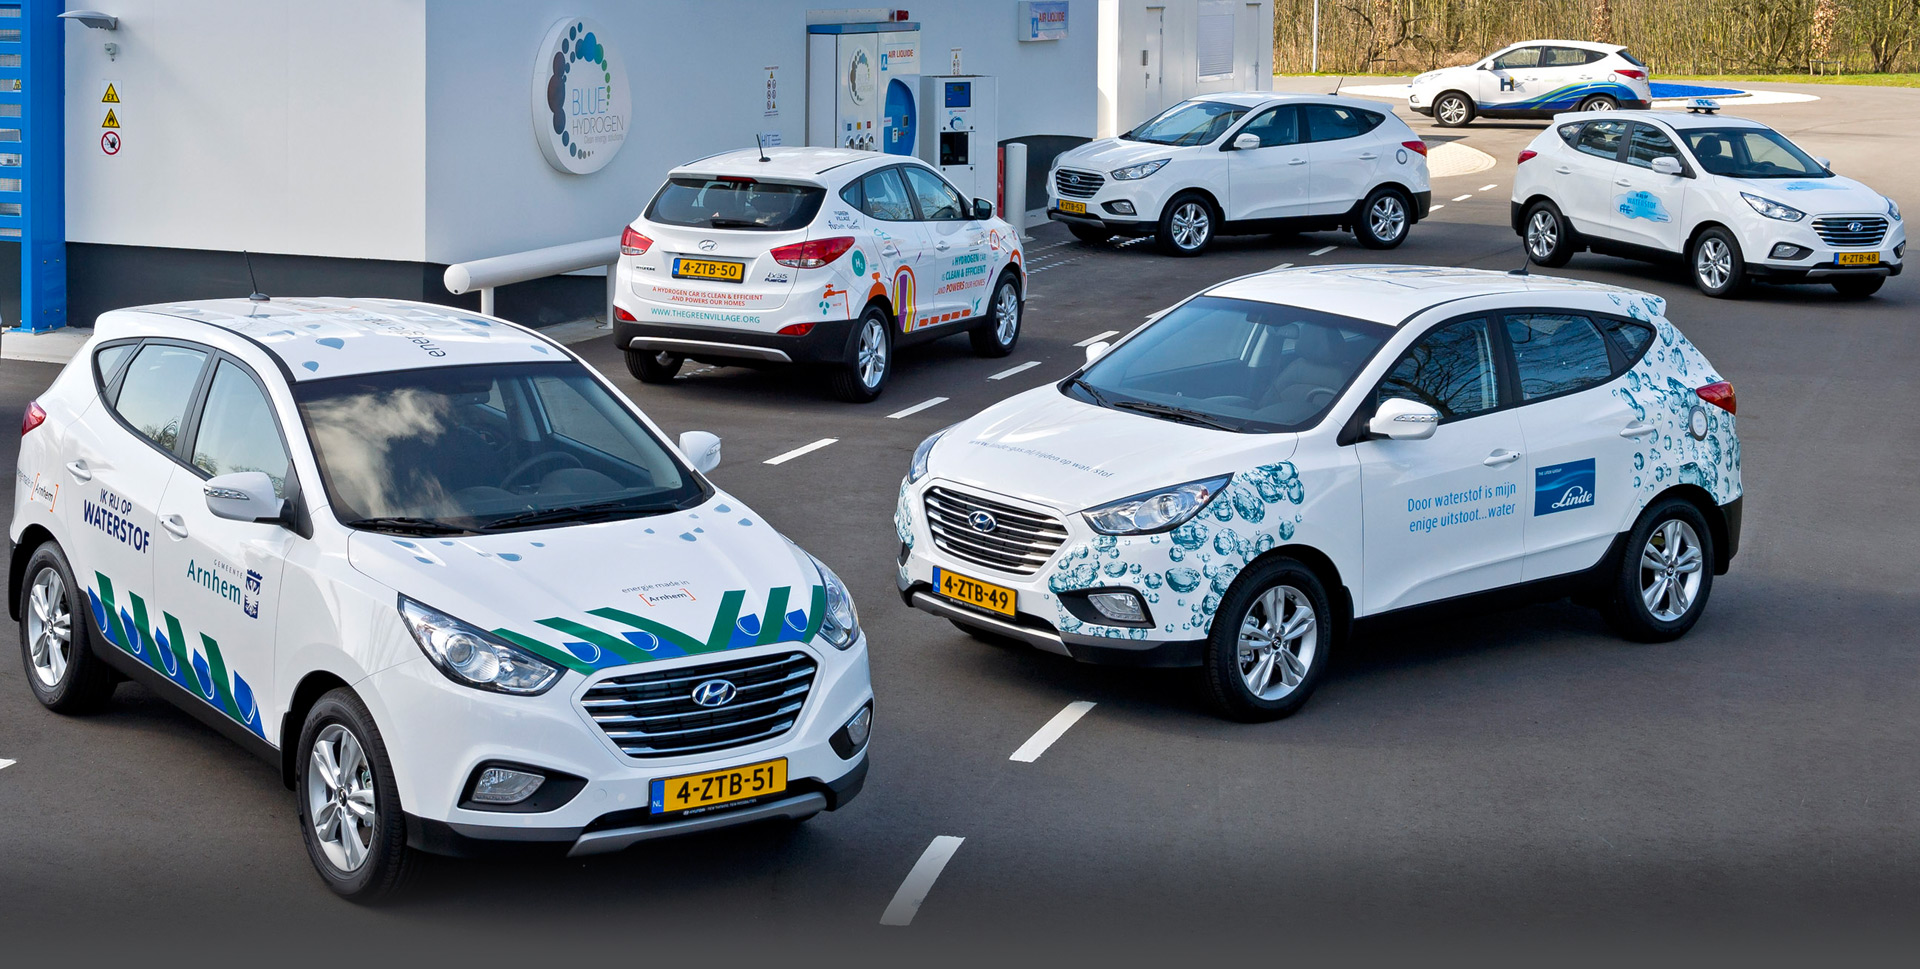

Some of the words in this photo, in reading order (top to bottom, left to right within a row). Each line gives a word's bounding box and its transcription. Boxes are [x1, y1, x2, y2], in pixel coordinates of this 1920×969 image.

[572, 86, 606, 116] BLUE
[572, 115, 624, 135] HYDROGEN
[955, 253, 979, 266] HYDROGEN
[1842, 253, 1877, 263] 4-ZTB-48
[682, 261, 738, 277] 4-ZTB-50
[946, 268, 960, 281] CLEAN
[965, 264, 987, 277] EFFICIENT
[657, 287, 687, 296] HYDROGEN
[946, 281, 965, 293] POWERS
[965, 281, 973, 289] OUR
[973, 278, 986, 287] HOMES
[650, 307, 761, 324] WWW.THEGREENVILLAGE.ORG
[34, 483, 54, 502] Arnhem
[1407, 498, 1432, 513] Door
[1434, 485, 1483, 508] waterstof
[1485, 486, 1493, 499] is
[1495, 482, 1517, 500] mijn
[1551, 485, 1593, 509] Linde
[99, 488, 108, 505] IK
[108, 492, 119, 511] RIJ
[121, 499, 132, 516] OP
[83, 499, 150, 554] WATERSTOF
[1409, 516, 1438, 534] enige
[213, 559, 243, 579] GEMEENTE
[186, 559, 241, 605] Arnhem
[621, 583, 654, 594] energie
[655, 580, 680, 588] made
[649, 592, 688, 602] Arnhem
[944, 575, 1009, 610] 4-ZTB-49
[676, 765, 774, 804] 4-ZTB-51
[652, 800, 662, 808] NL
